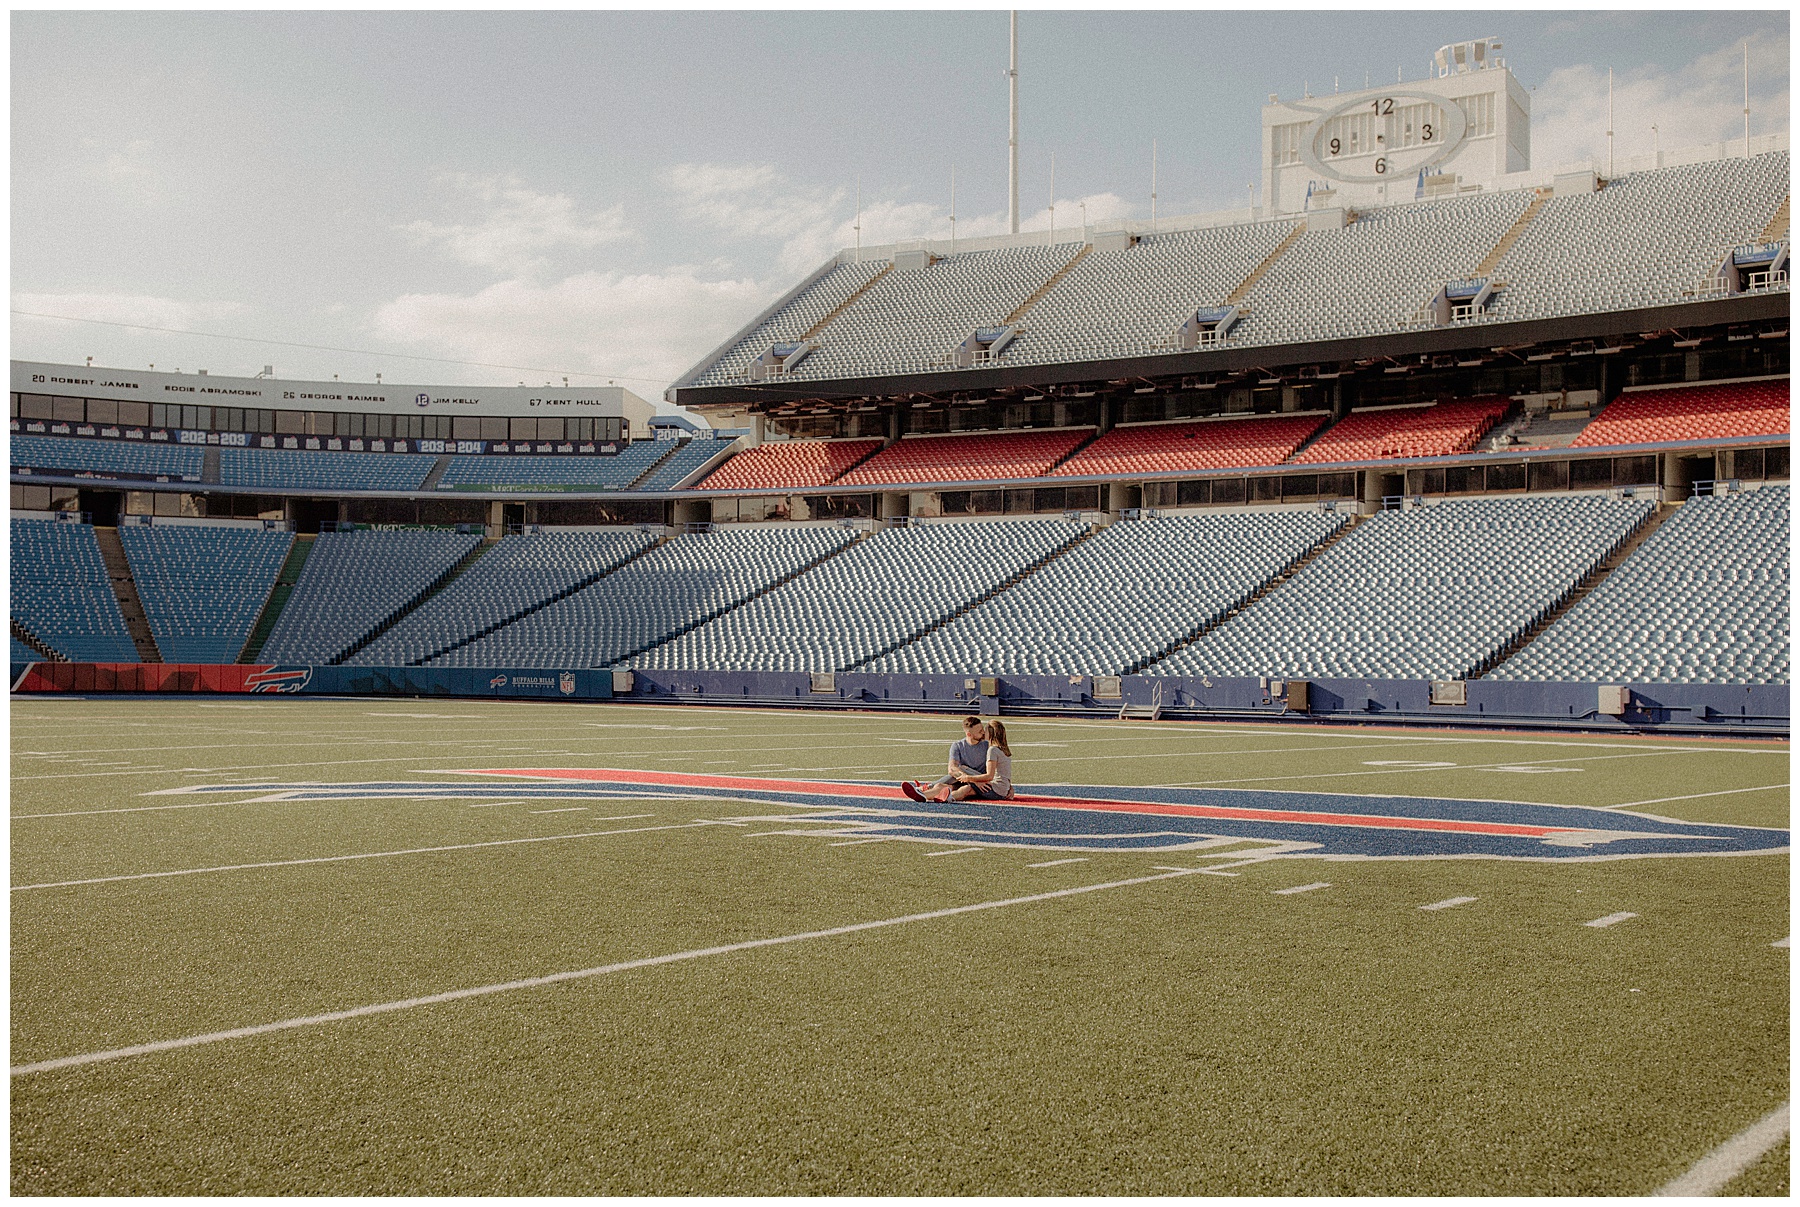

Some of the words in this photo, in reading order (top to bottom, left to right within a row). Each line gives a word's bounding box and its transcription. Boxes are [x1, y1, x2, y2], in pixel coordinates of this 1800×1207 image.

[1372, 98, 1394, 116] 12
[1422, 124, 1433, 140] 3
[1330, 138, 1341, 154] 9
[1375, 158, 1386, 174] 6
[32, 374, 45, 383] 20
[50, 377, 94, 386] ROBERT
[100, 381, 139, 389] JAMES
[164, 385, 195, 393] EDDIE
[200, 387, 262, 396] ABRAMOSKI
[283, 391, 295, 400] 26
[417, 395, 429, 406] 12
[180, 430, 207, 445] 202
[220, 432, 246, 446] 203
[656, 429, 679, 441] 204
[691, 429, 714, 441] 205
[421, 441, 445, 453] 203
[457, 441, 482, 453] 204
[561, 681, 574, 691] NFL
